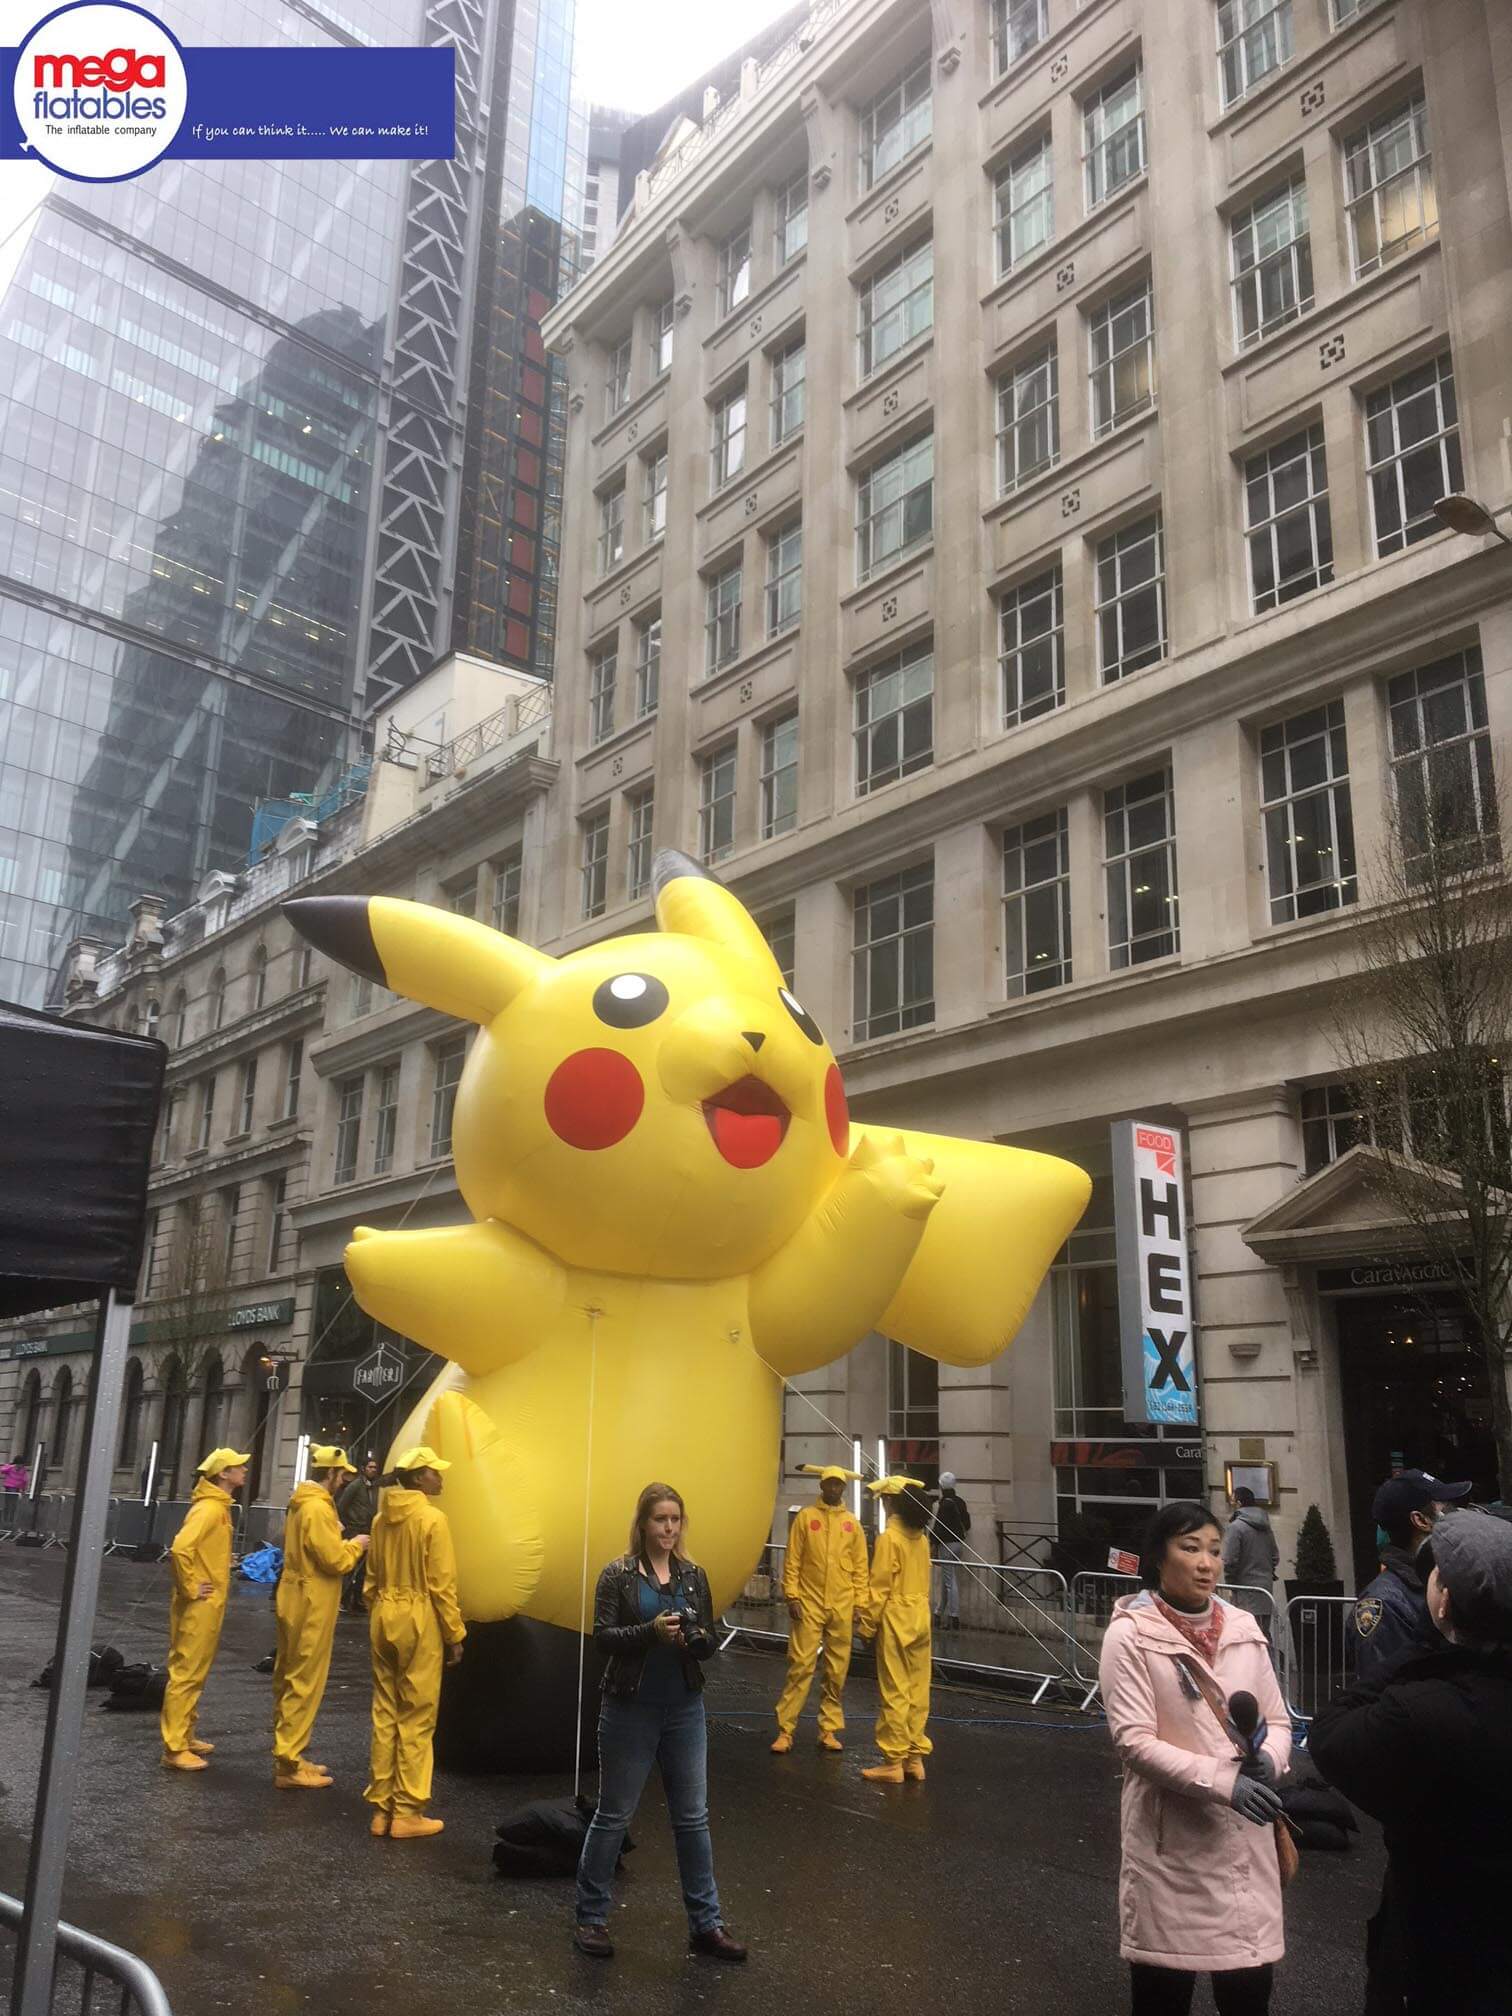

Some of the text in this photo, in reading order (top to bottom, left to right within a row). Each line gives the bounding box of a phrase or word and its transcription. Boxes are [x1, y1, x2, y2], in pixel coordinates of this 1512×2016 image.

[1139, 1131, 1172, 1150] FOOD
[1140, 1177, 1192, 1392] HEX
[257, 1303, 280, 1322] BANK
